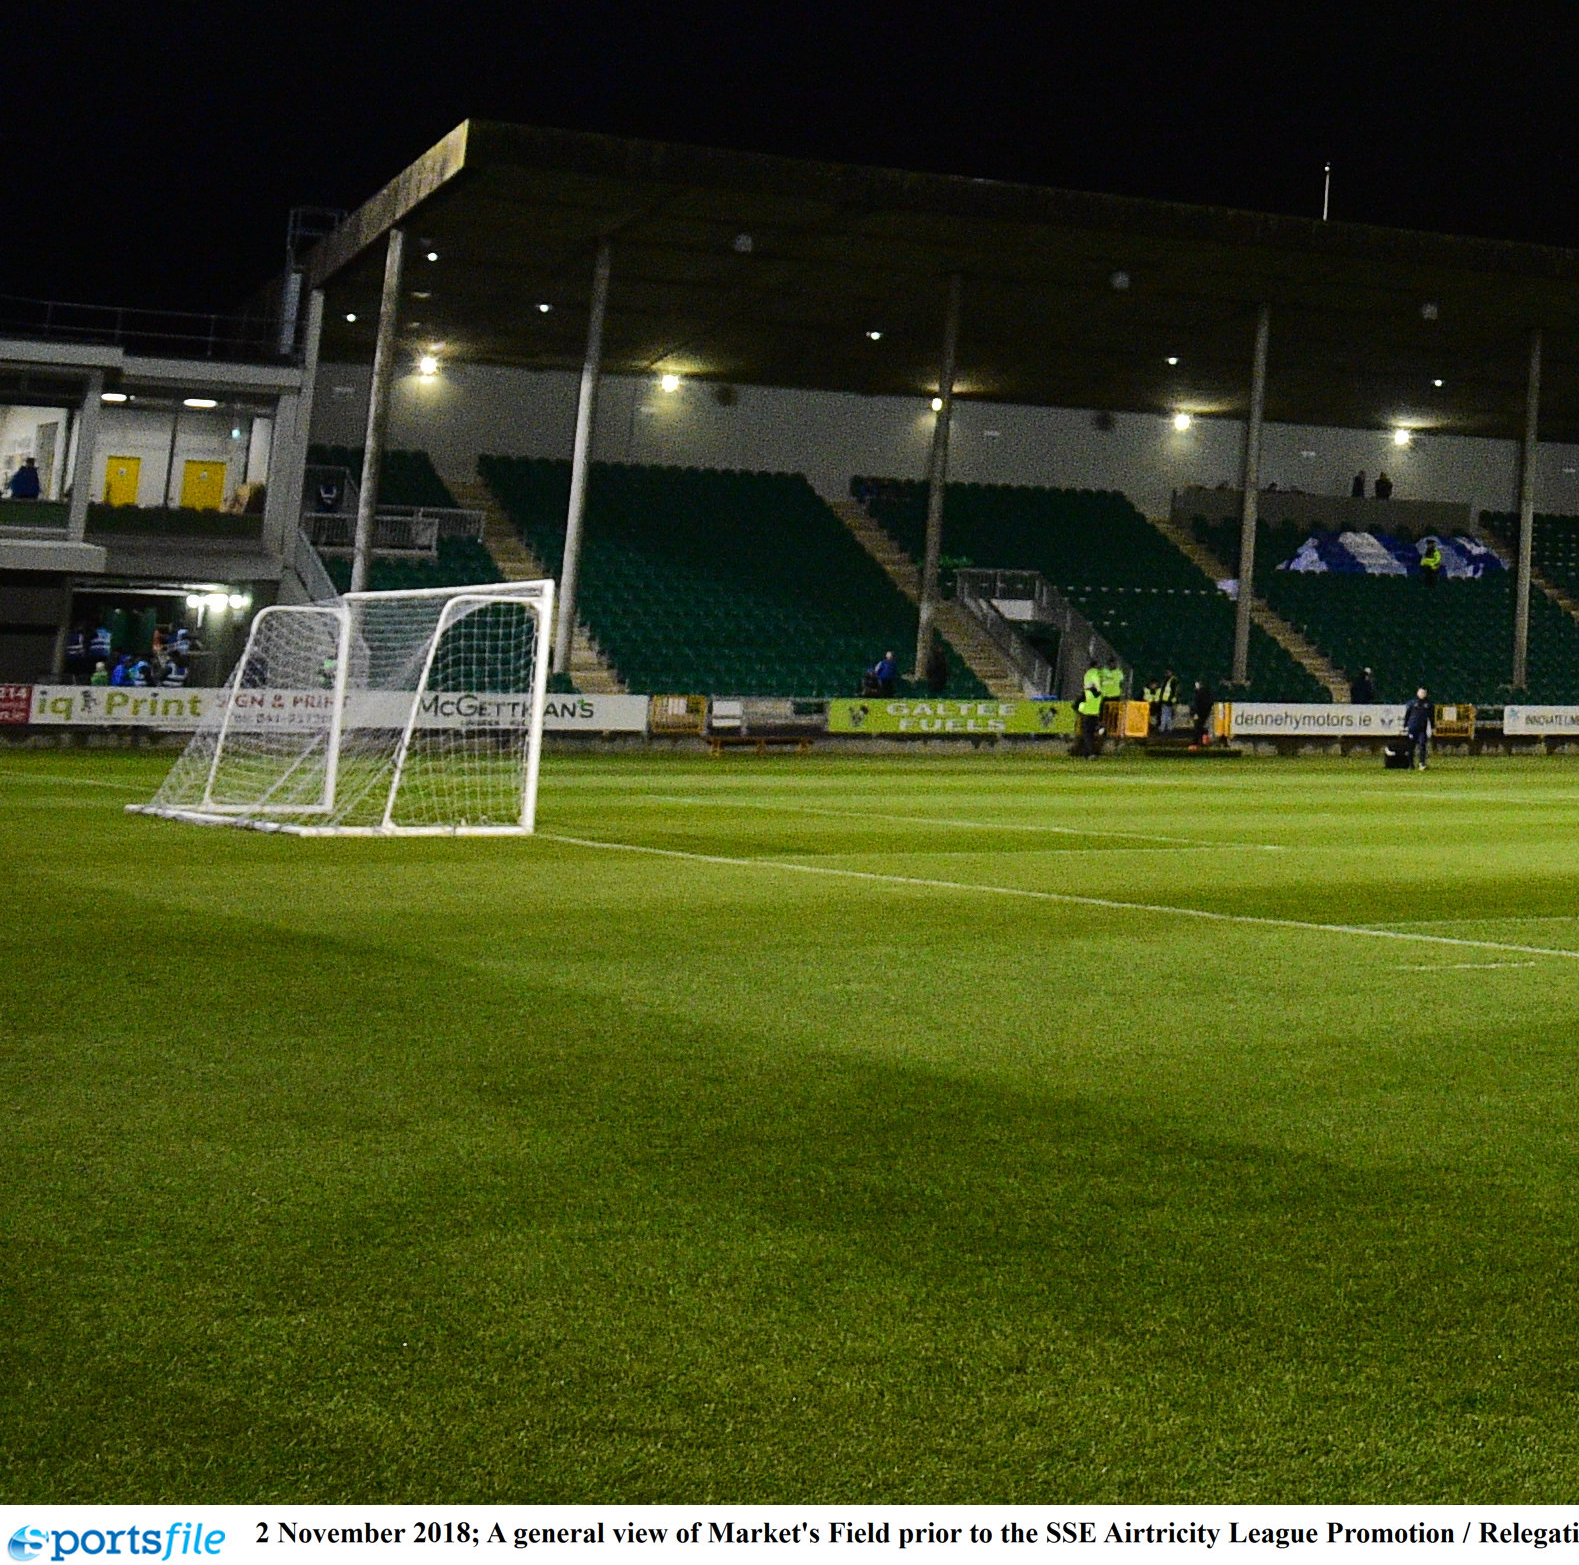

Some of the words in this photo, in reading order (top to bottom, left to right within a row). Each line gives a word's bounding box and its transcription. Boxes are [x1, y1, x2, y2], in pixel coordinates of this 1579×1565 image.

[105, 691, 201, 717] Print
[886, 702, 1018, 716] GALTEE
[900, 719, 1006, 732] FUELS
